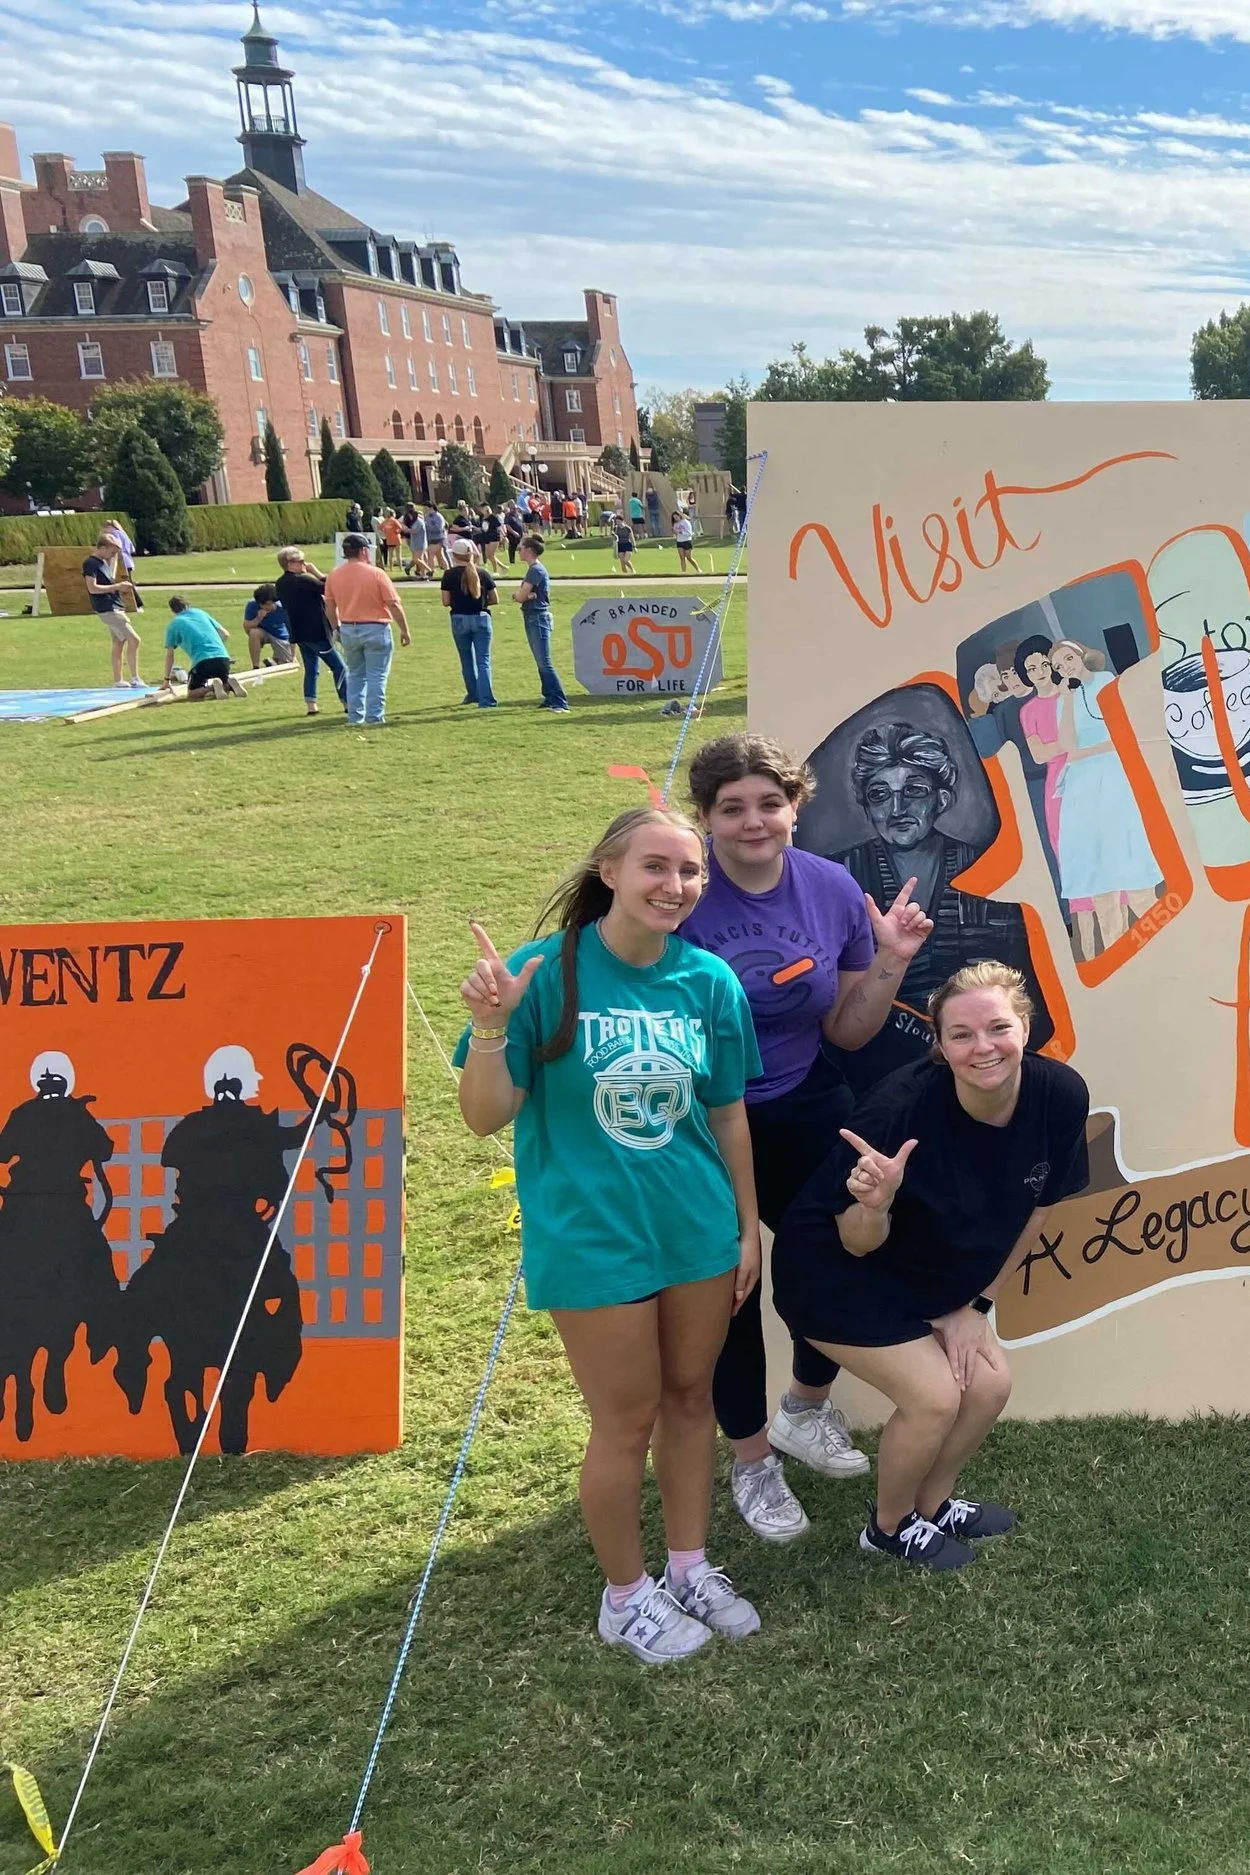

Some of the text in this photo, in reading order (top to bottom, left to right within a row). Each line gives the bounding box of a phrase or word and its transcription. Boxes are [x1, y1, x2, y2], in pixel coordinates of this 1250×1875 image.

[788, 450, 1179, 628] Visit
[608, 603, 678, 620] BRANDED
[602, 616, 693, 681] OSU
[616, 679, 686, 692] FOR LIFE
[1130, 891, 1184, 949] 1950
[777, 925, 835, 979] TUTTLE
[587, 1046, 610, 1068] FOOD
